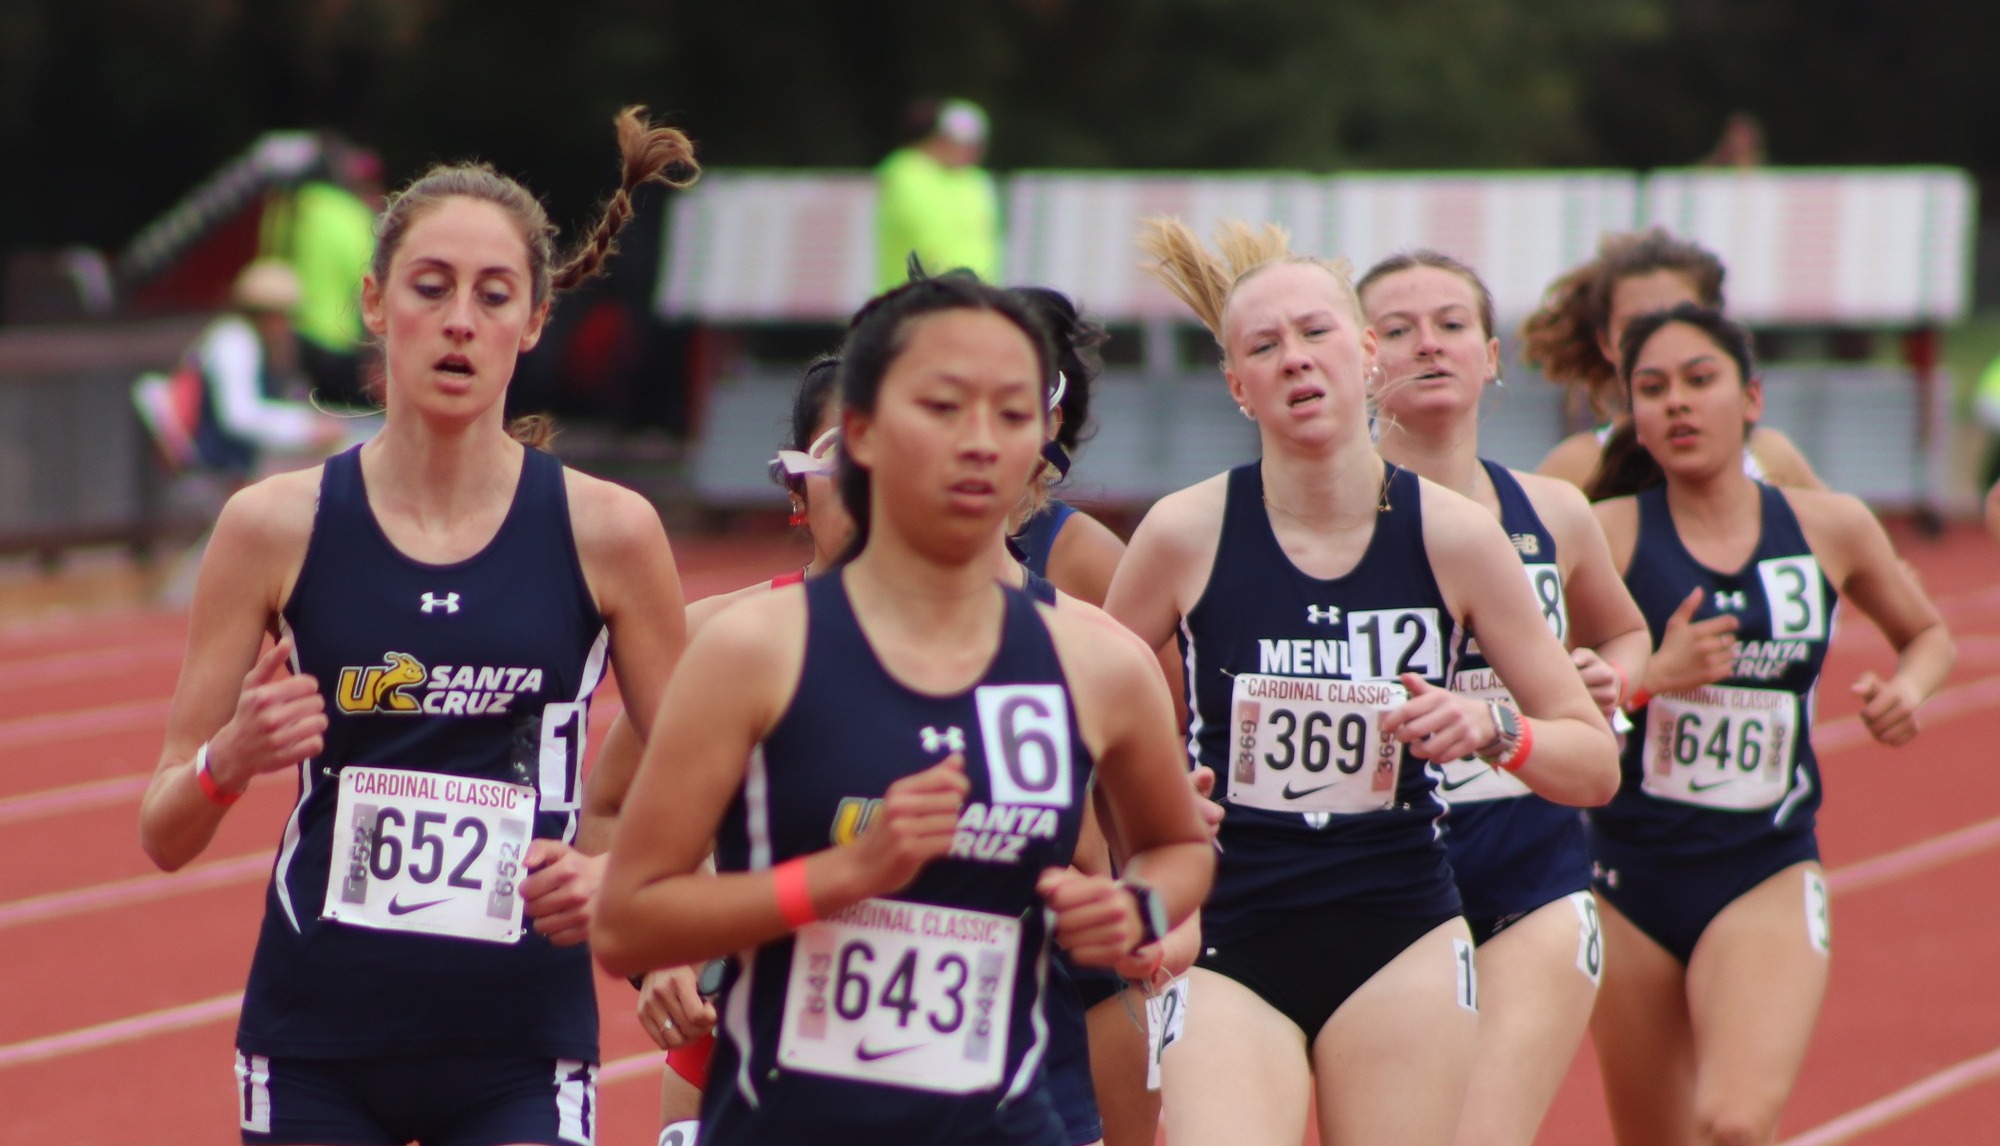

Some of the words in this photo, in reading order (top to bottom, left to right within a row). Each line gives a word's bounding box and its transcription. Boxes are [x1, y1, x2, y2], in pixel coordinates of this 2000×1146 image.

[1535, 568, 1562, 641] 8
[1775, 564, 1811, 633] 3
[1258, 639, 1352, 675] MENL
[1356, 612, 1428, 677] 12
[1729, 659, 1788, 678] RUZ
[422, 691, 515, 715] CRUZ
[427, 665, 543, 692] SANTA
[1248, 677, 1323, 702] CARDINAL
[1328, 683, 1391, 705] CLASSIC
[553, 710, 580, 804] 1
[999, 694, 1059, 794] 6
[1239, 720, 1257, 765] 369
[1264, 708, 1367, 775] 369
[1674, 711, 1764, 773] 646
[354, 771, 439, 801] CARDINAL
[444, 779, 518, 810] CLASSIC
[369, 806, 489, 890] 652
[950, 830, 1029, 863] RUZ
[956, 802, 1059, 839] ANTA
[495, 841, 521, 897] 652
[922, 910, 1001, 945] CLASSIC
[1584, 898, 1600, 986] 8
[834, 938, 969, 1034] 643
